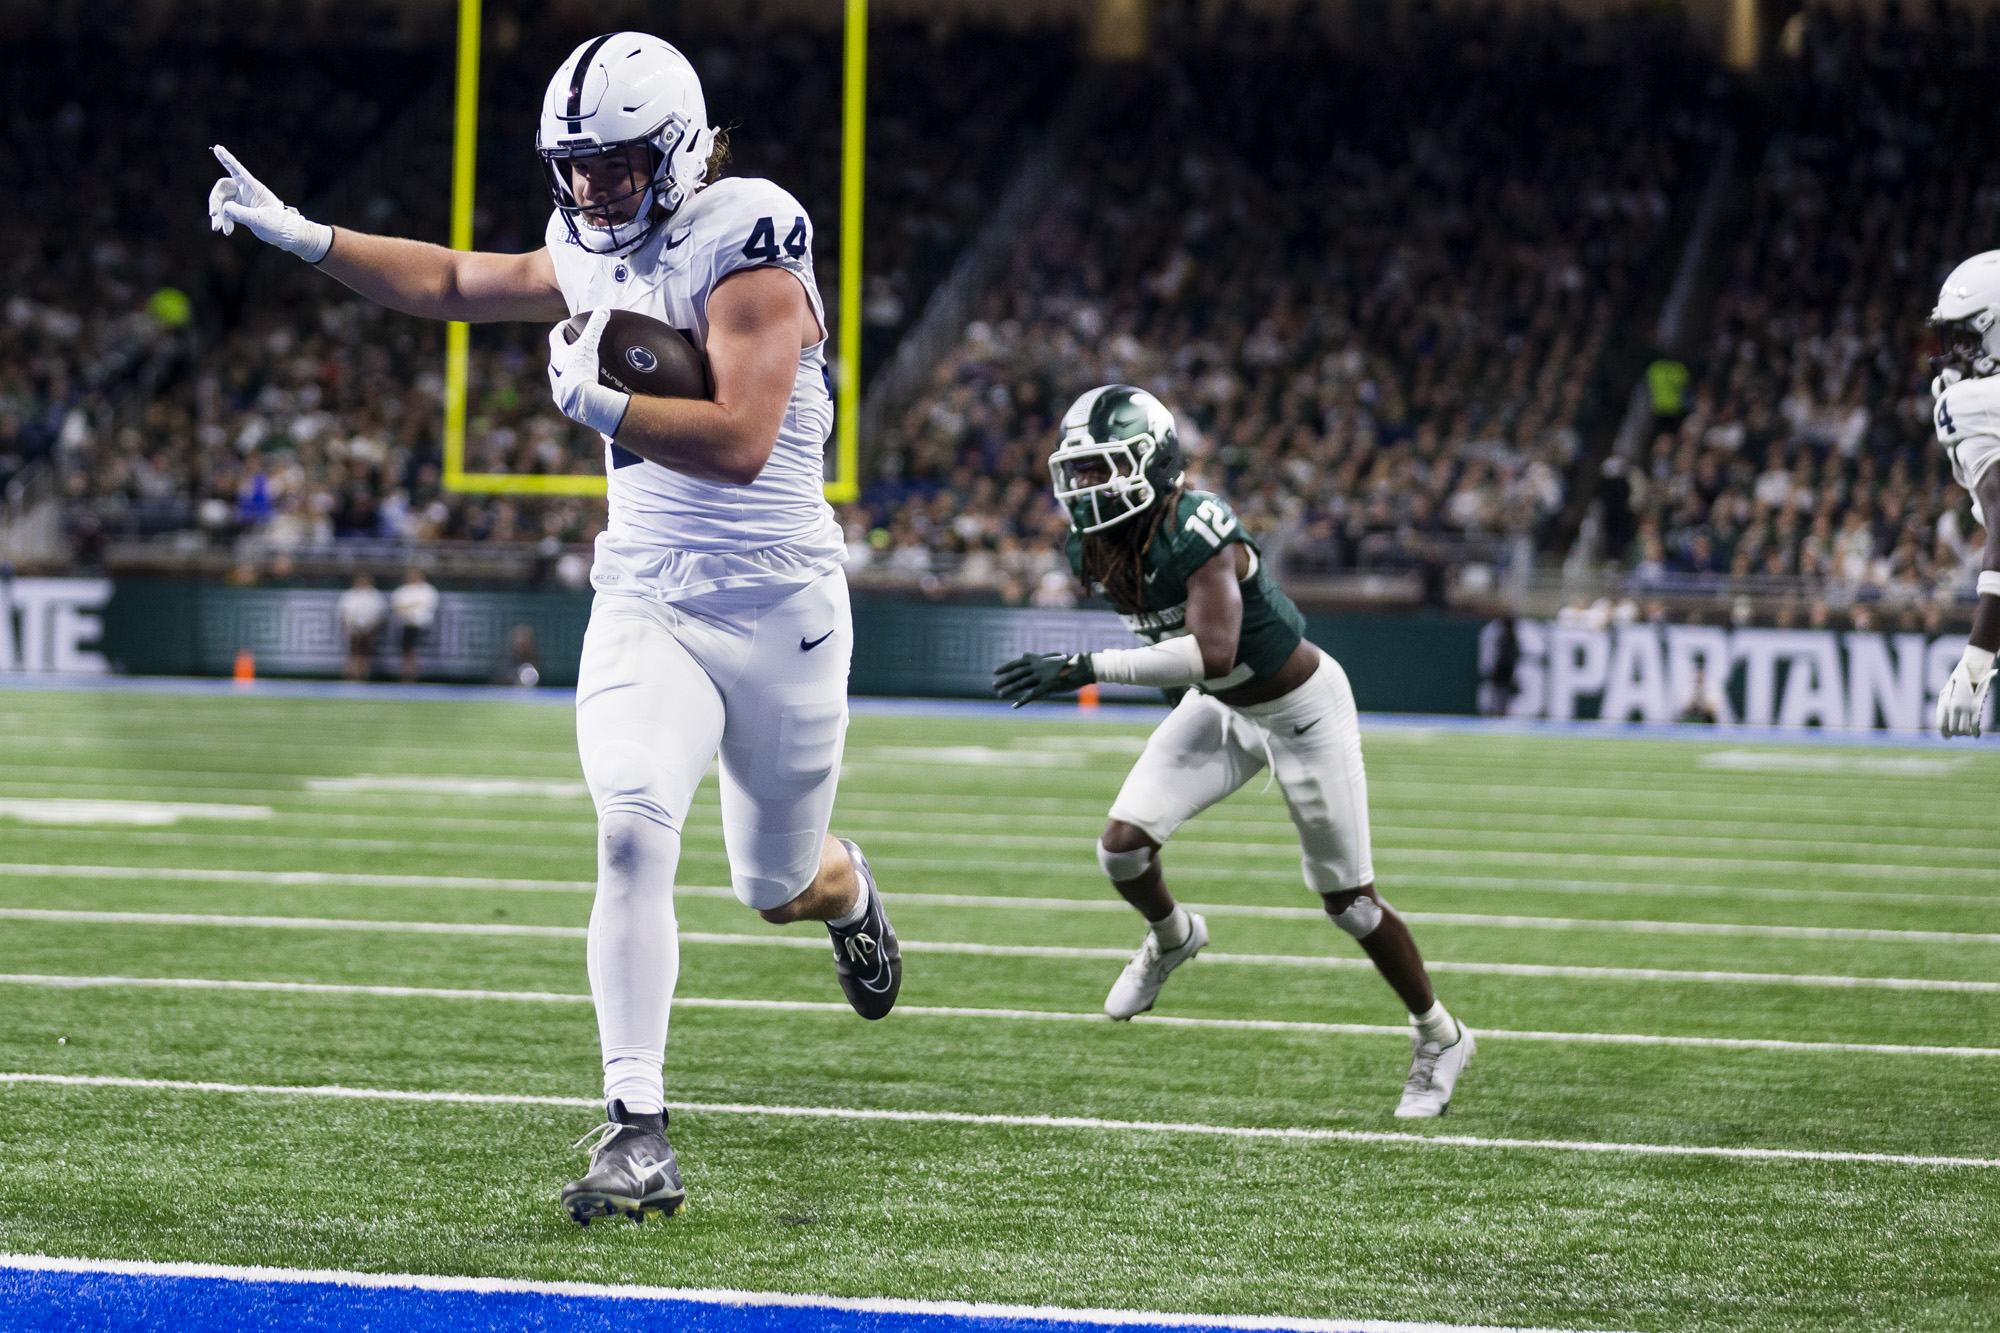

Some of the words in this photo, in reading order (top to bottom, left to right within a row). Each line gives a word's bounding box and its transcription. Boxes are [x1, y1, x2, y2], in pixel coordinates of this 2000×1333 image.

[741, 216, 807, 262] 44
[1184, 500, 1237, 548] 12
[0, 576, 113, 672] TE
